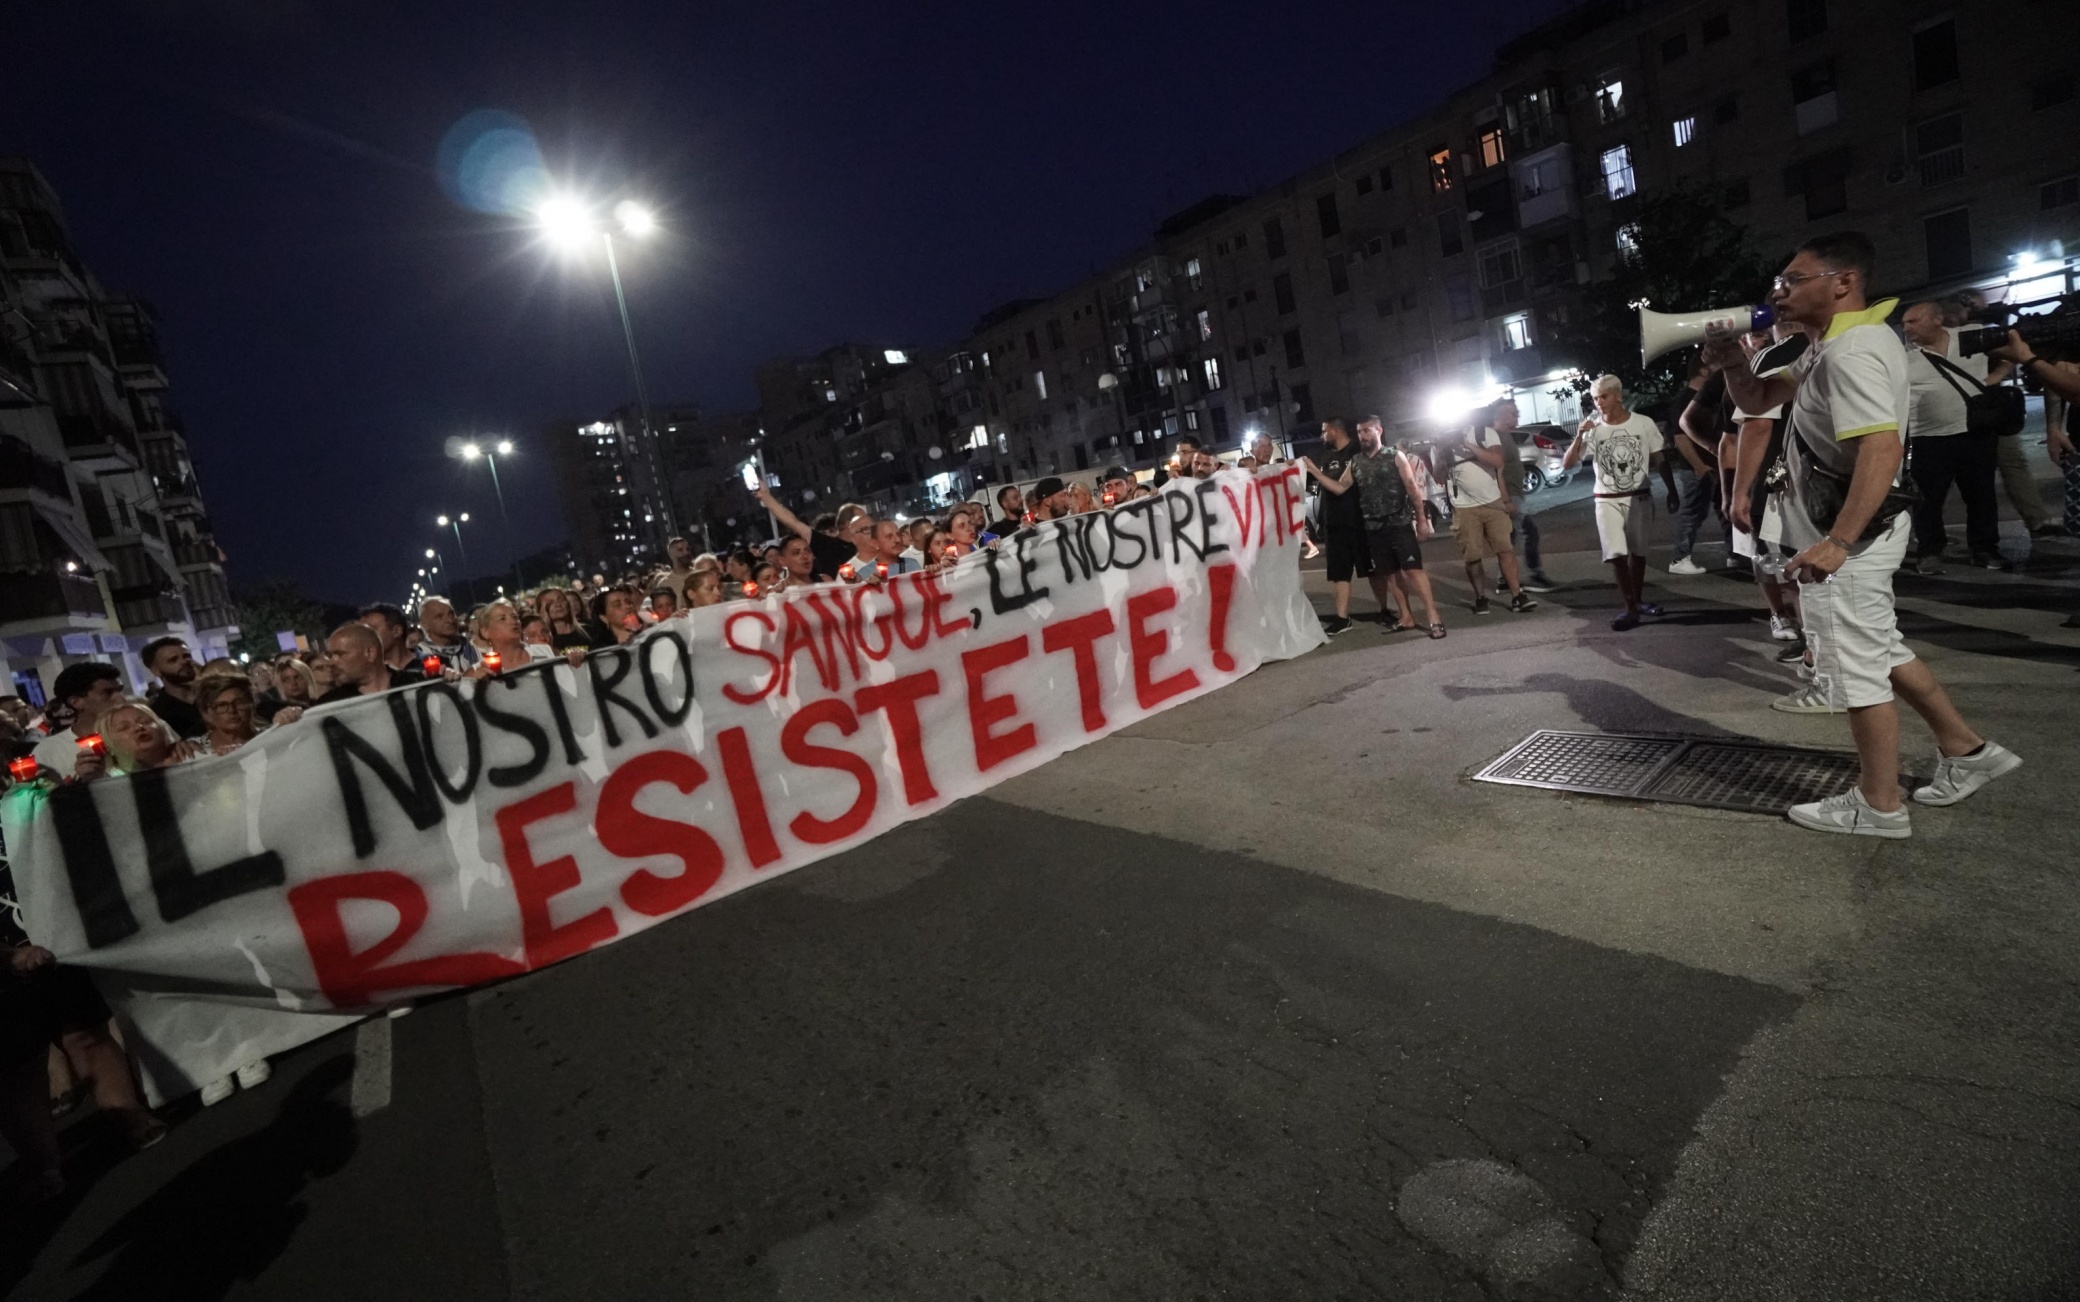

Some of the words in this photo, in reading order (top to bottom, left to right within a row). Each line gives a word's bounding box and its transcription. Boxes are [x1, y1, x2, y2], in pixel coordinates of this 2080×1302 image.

[49, 768, 286, 949] IL
[321, 630, 695, 858] NOSTRO
[722, 570, 982, 706] SANGUE,
[986, 529, 1049, 616] LE
[1055, 482, 1230, 583] NOSTRE
[1223, 468, 1304, 547] VITE
[288, 564, 1235, 1008] RESISTETE!
